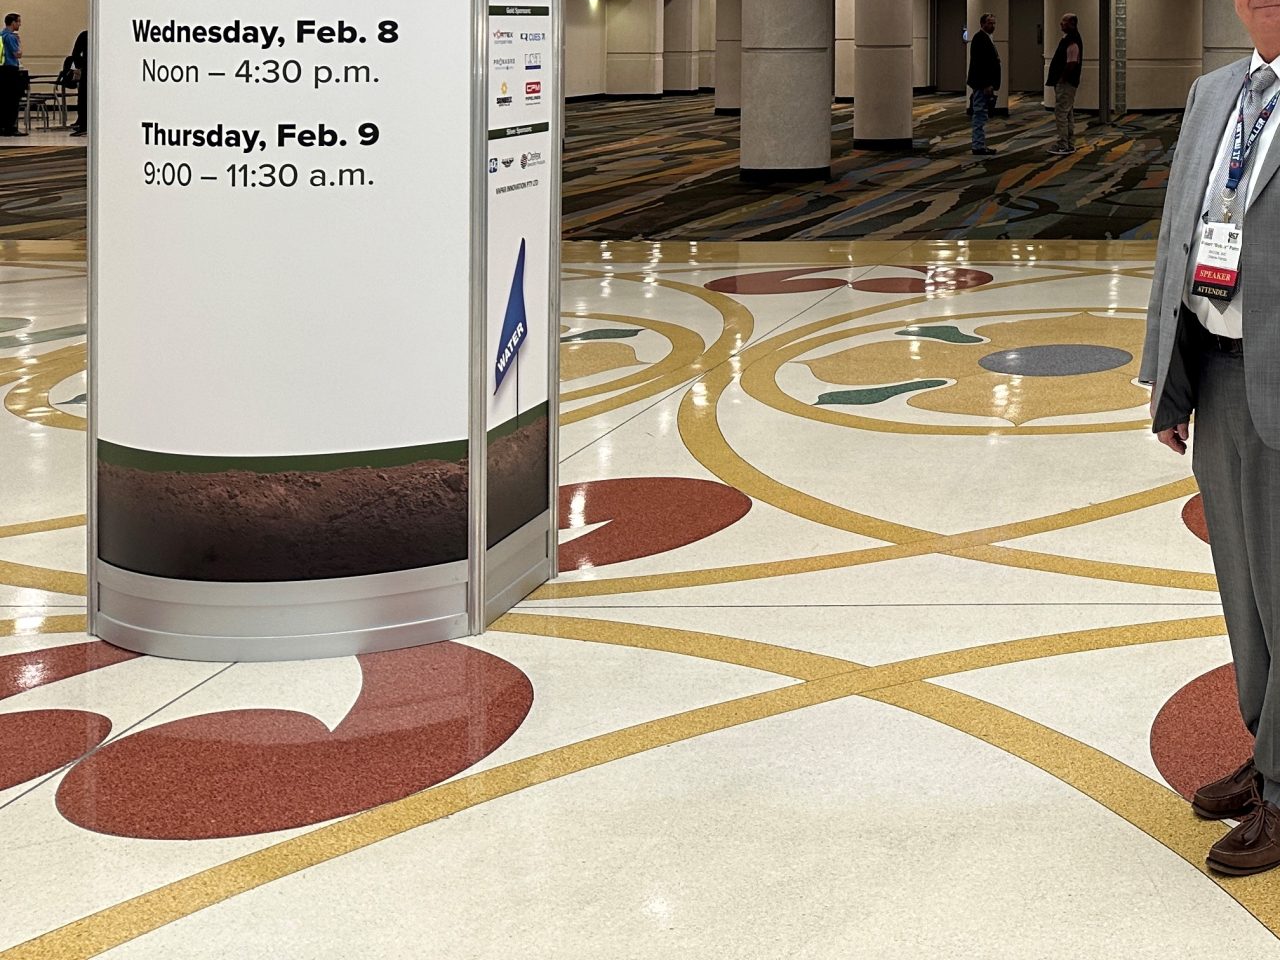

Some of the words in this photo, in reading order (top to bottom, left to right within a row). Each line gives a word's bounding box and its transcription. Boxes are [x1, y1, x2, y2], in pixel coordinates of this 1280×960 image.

[132, 19, 286, 49] Wednesday,
[296, 20, 367, 44] Feb.
[377, 20, 399, 44] 8
[142, 59, 199, 83] Noon
[234, 59, 301, 84] 4:30
[314, 64, 380, 89] p.m.
[141, 122, 266, 153] Thursday,
[277, 124, 347, 149] Feb.
[358, 122, 380, 146] 9
[144, 161, 192, 187] 9:00
[226, 162, 298, 188] 11:30
[310, 168, 375, 188] a.m.
[1199, 270, 1231, 281] SPEAKER
[1198, 286, 1228, 296] ATTENDEE
[497, 322, 524, 373] WATER
